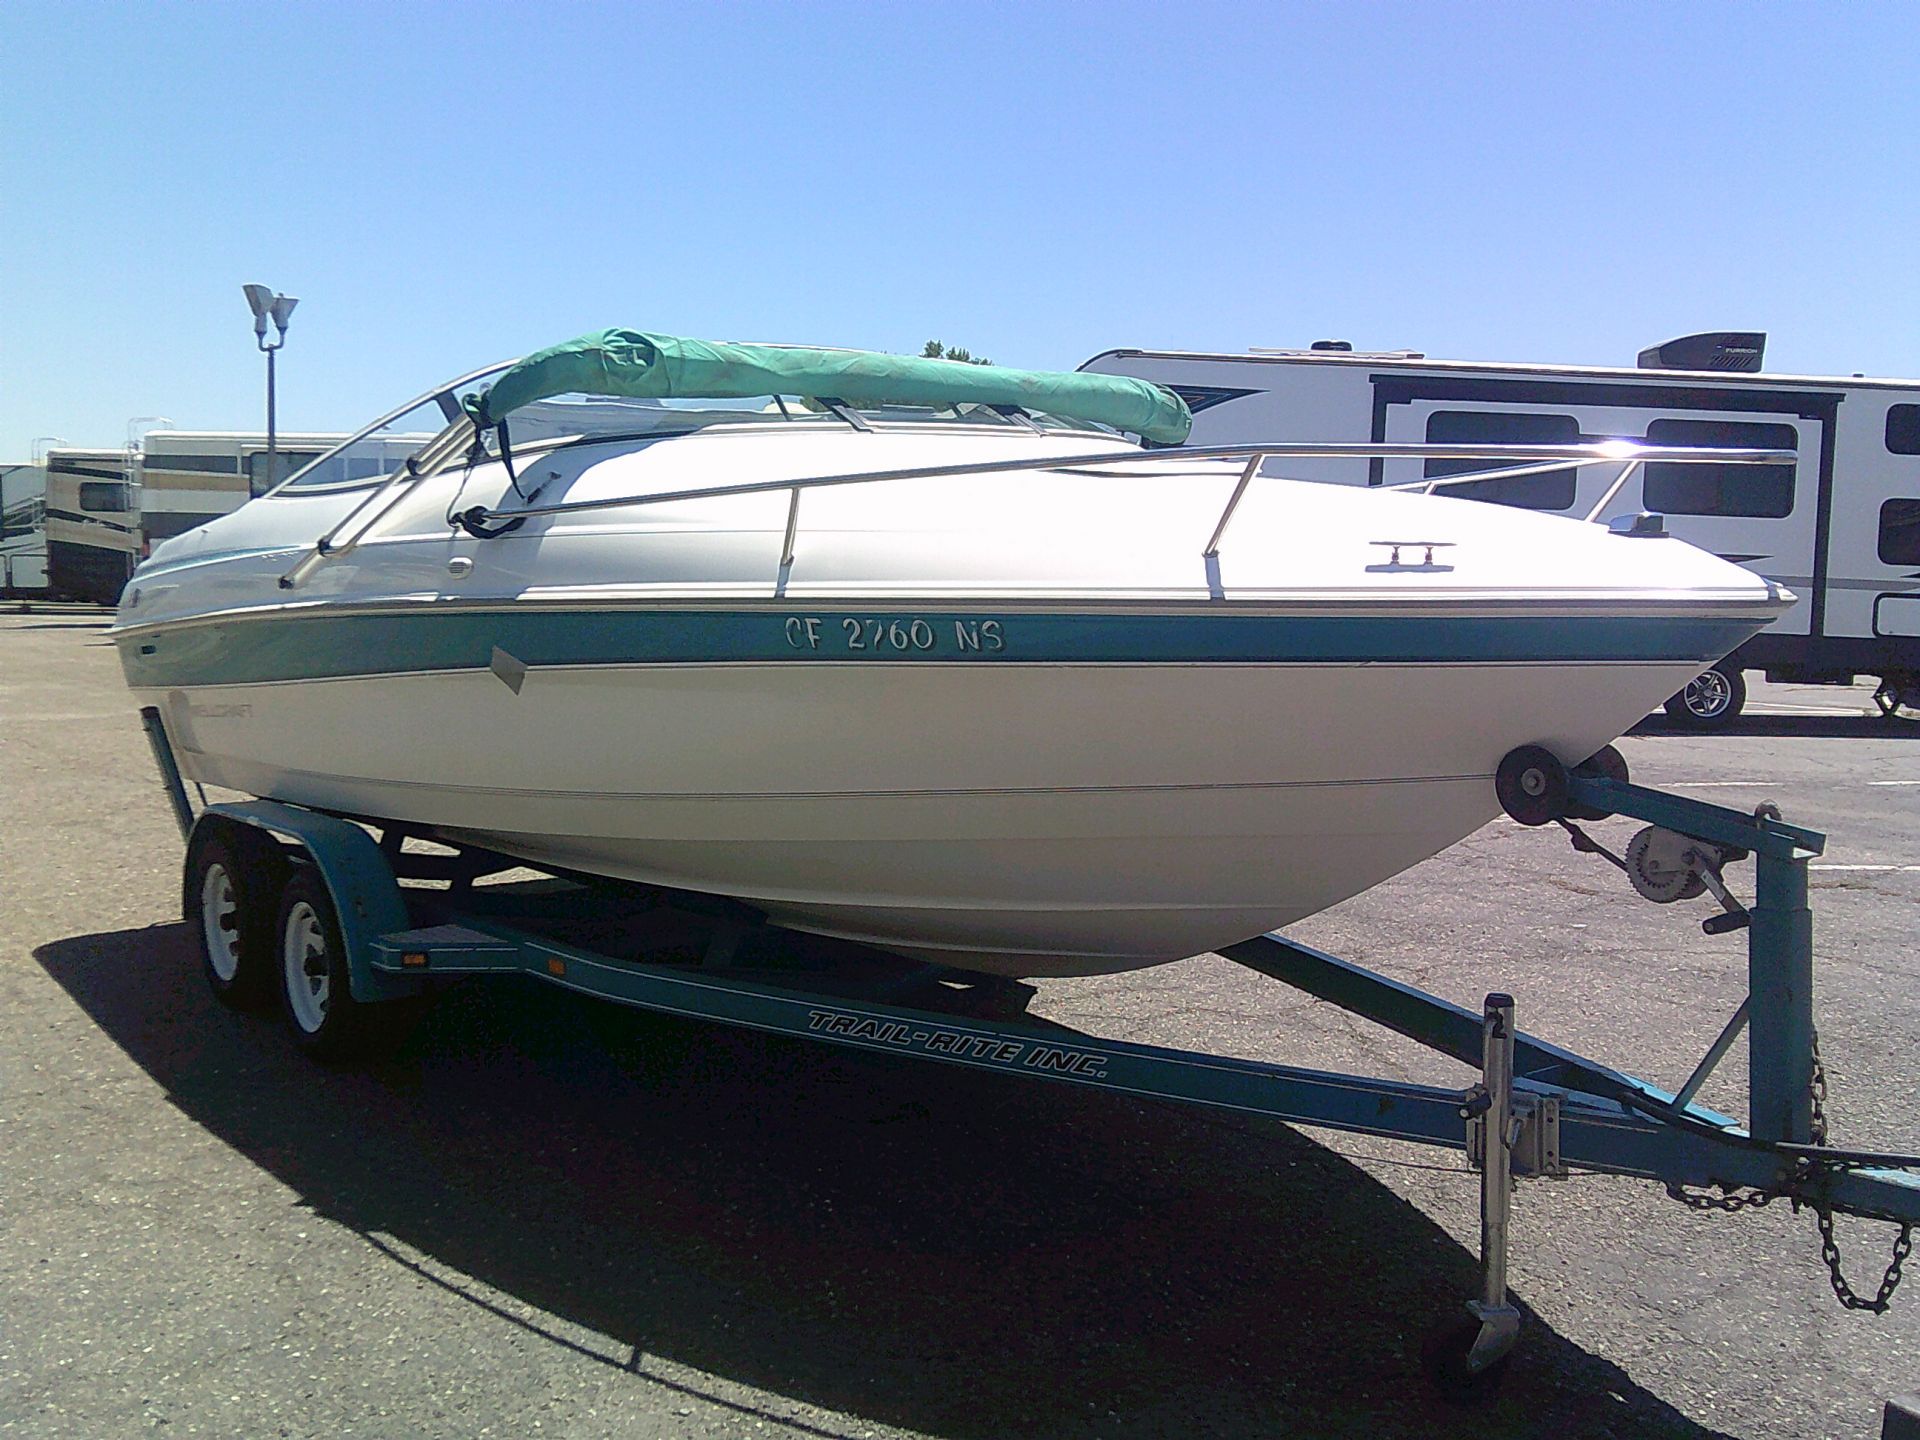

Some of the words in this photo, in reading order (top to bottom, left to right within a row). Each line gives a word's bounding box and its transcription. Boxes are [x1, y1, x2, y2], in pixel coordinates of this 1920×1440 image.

[785, 616, 822, 649] CF
[842, 616, 934, 650] 2760
[954, 619, 1003, 650] NS
[808, 1010, 1025, 1063] TRAIL-RITE
[1023, 1046, 1109, 1079] INC.
